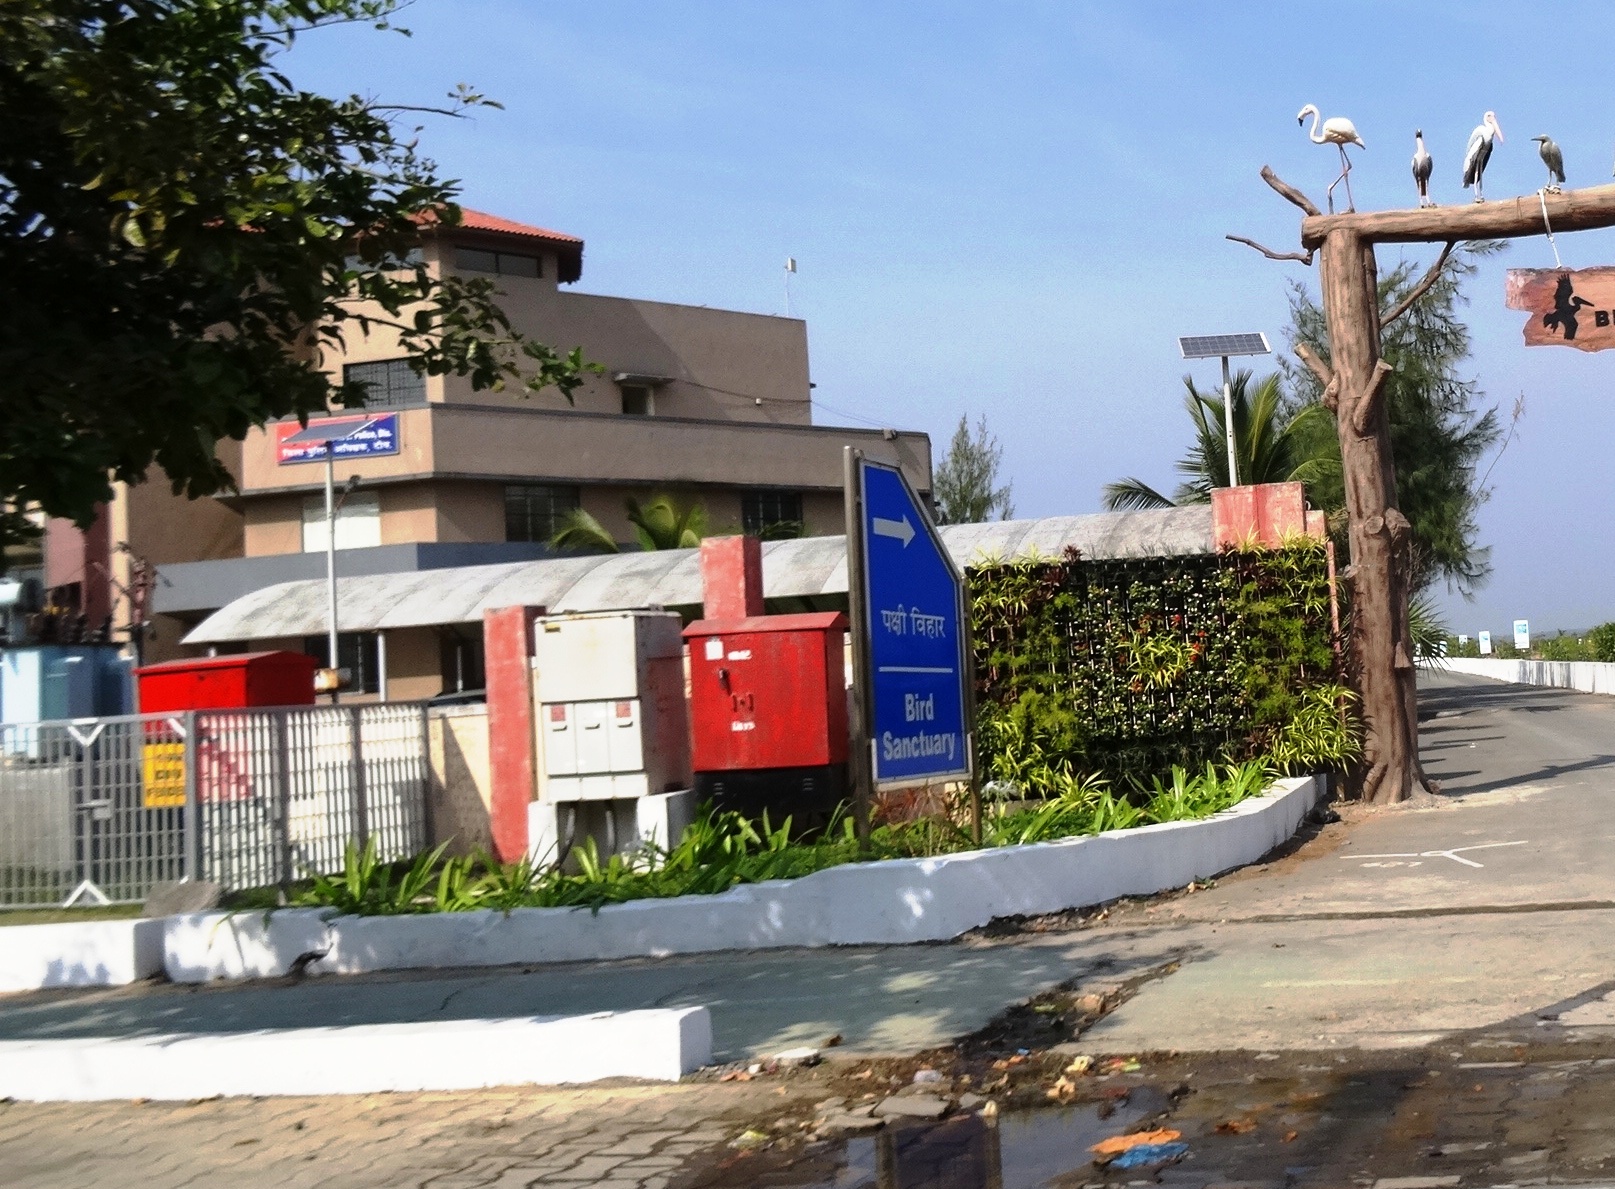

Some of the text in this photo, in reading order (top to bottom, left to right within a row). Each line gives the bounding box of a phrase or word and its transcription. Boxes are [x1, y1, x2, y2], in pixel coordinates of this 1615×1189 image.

[881, 604, 946, 639] पक्षी विहार
[904, 693, 934, 722] Bird
[883, 730, 956, 761] Sanctuary
